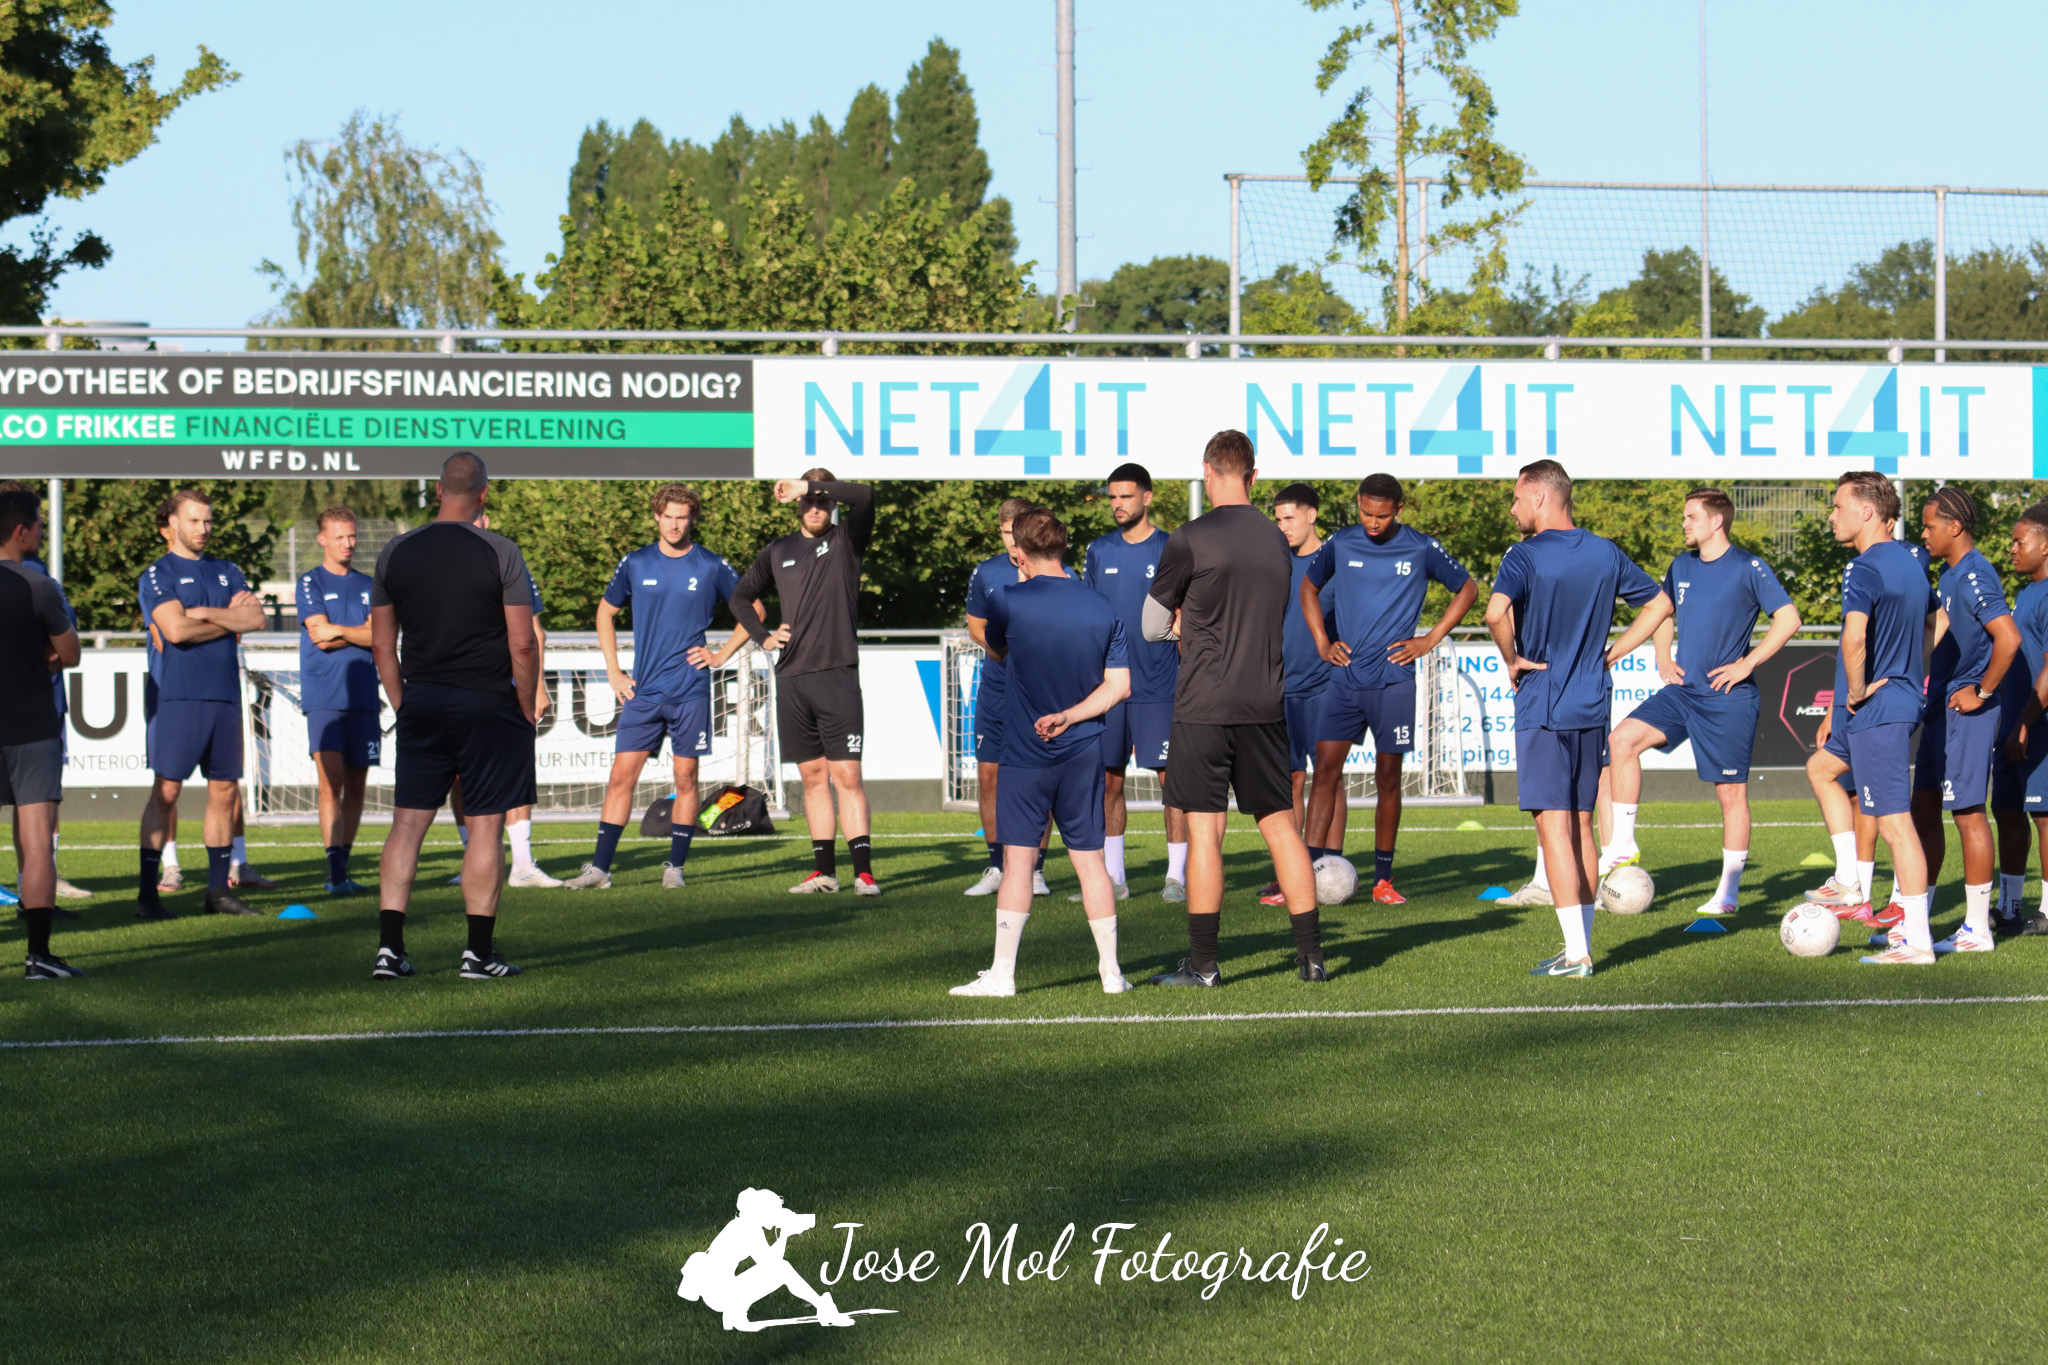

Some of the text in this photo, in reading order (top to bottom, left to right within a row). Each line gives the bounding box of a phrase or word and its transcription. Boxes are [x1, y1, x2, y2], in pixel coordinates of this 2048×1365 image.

[178, 367, 224, 394] OF
[233, 368, 612, 397] BEDRIJFSFINANCIERING
[622, 372, 742, 399] NODIG?
[0, 412, 626, 440] CO FRIKKEE FINANCIËLE DIENSTVERLENING
[804, 363, 1147, 475] NET4IT
[1246, 365, 1574, 474] NET4IT
[1670, 367, 1986, 475] NET4IT
[222, 451, 361, 471] WFFD.NL
[1145, 564, 1155, 578] 3
[1395, 561, 1412, 576] 15
[218, 574, 229, 587] 5
[687, 577, 698, 591] 2
[698, 731, 706, 745] 2
[1393, 726, 1410, 740] 15
[847, 735, 862, 747] 22
[976, 735, 984, 749] 7
